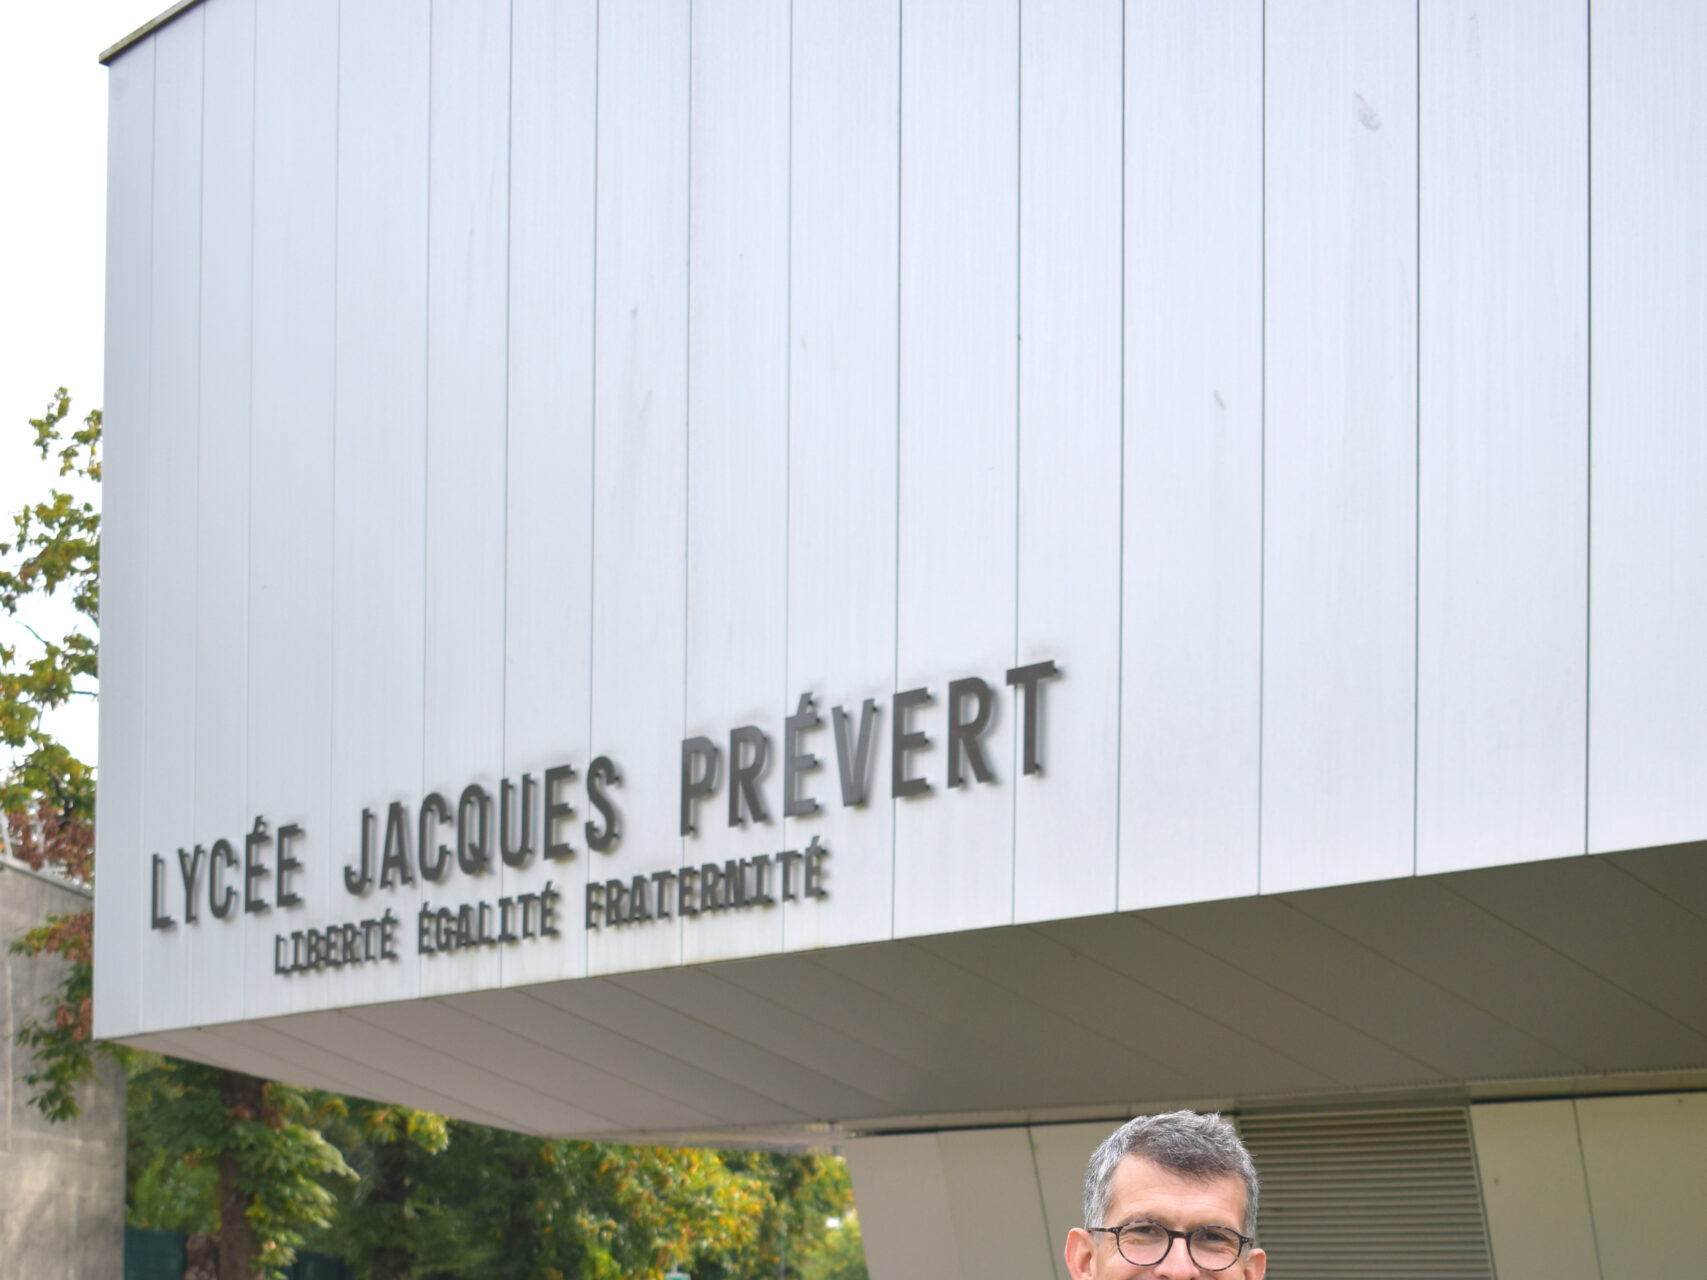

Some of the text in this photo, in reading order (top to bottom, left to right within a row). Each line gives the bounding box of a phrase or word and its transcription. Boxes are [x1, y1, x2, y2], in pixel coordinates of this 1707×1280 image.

[152, 660, 1060, 930] LYCÉE JACQUES PRÉVERT
[275, 835, 828, 975] LIBERTÉ ÉGALITÉ FRATERNITÉ
